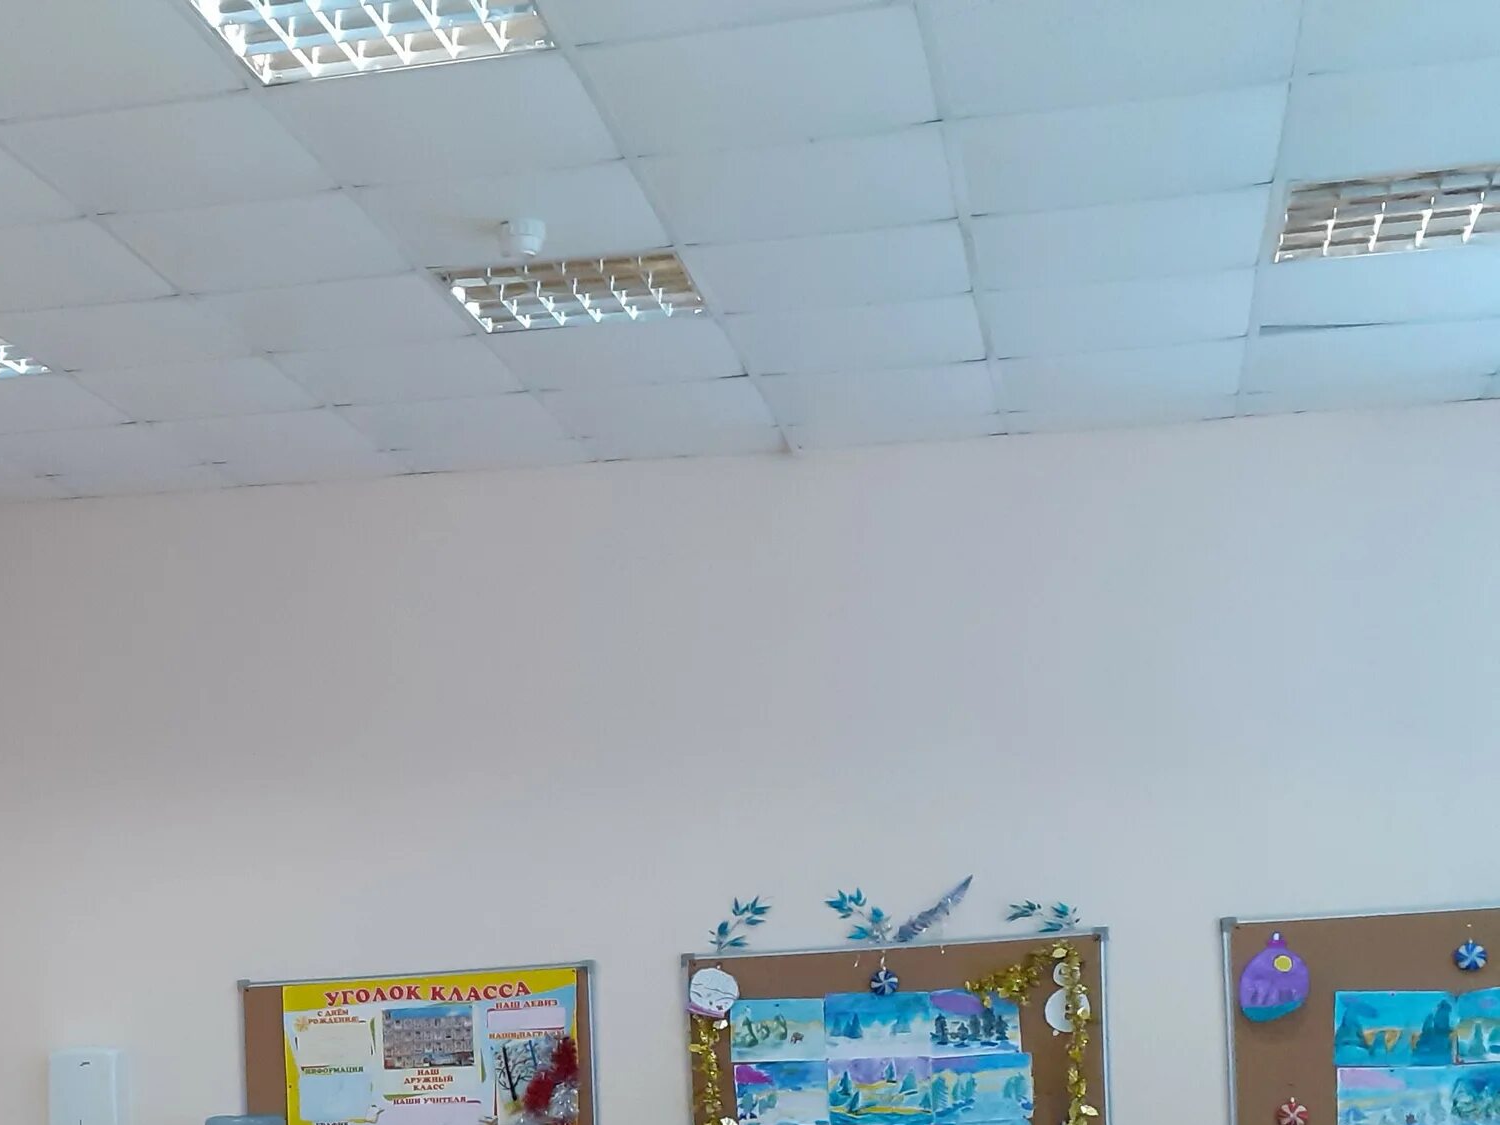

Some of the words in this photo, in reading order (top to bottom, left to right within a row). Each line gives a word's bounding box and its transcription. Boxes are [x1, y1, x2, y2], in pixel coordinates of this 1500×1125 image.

[325, 985, 421, 1006] УГОЛОК
[430, 981, 531, 1001] КЛАССА
[496, 1001, 520, 1009] НАШ
[523, 999, 558, 1008] ДЕВИЗ
[305, 1066, 364, 1075] ИНФОРМАЦИЯ
[417, 1068, 440, 1076] НАШ
[404, 1075, 454, 1084] ДРУЖНЫЙ
[423, 1096, 467, 1104] УЧИТЕЛЯ
